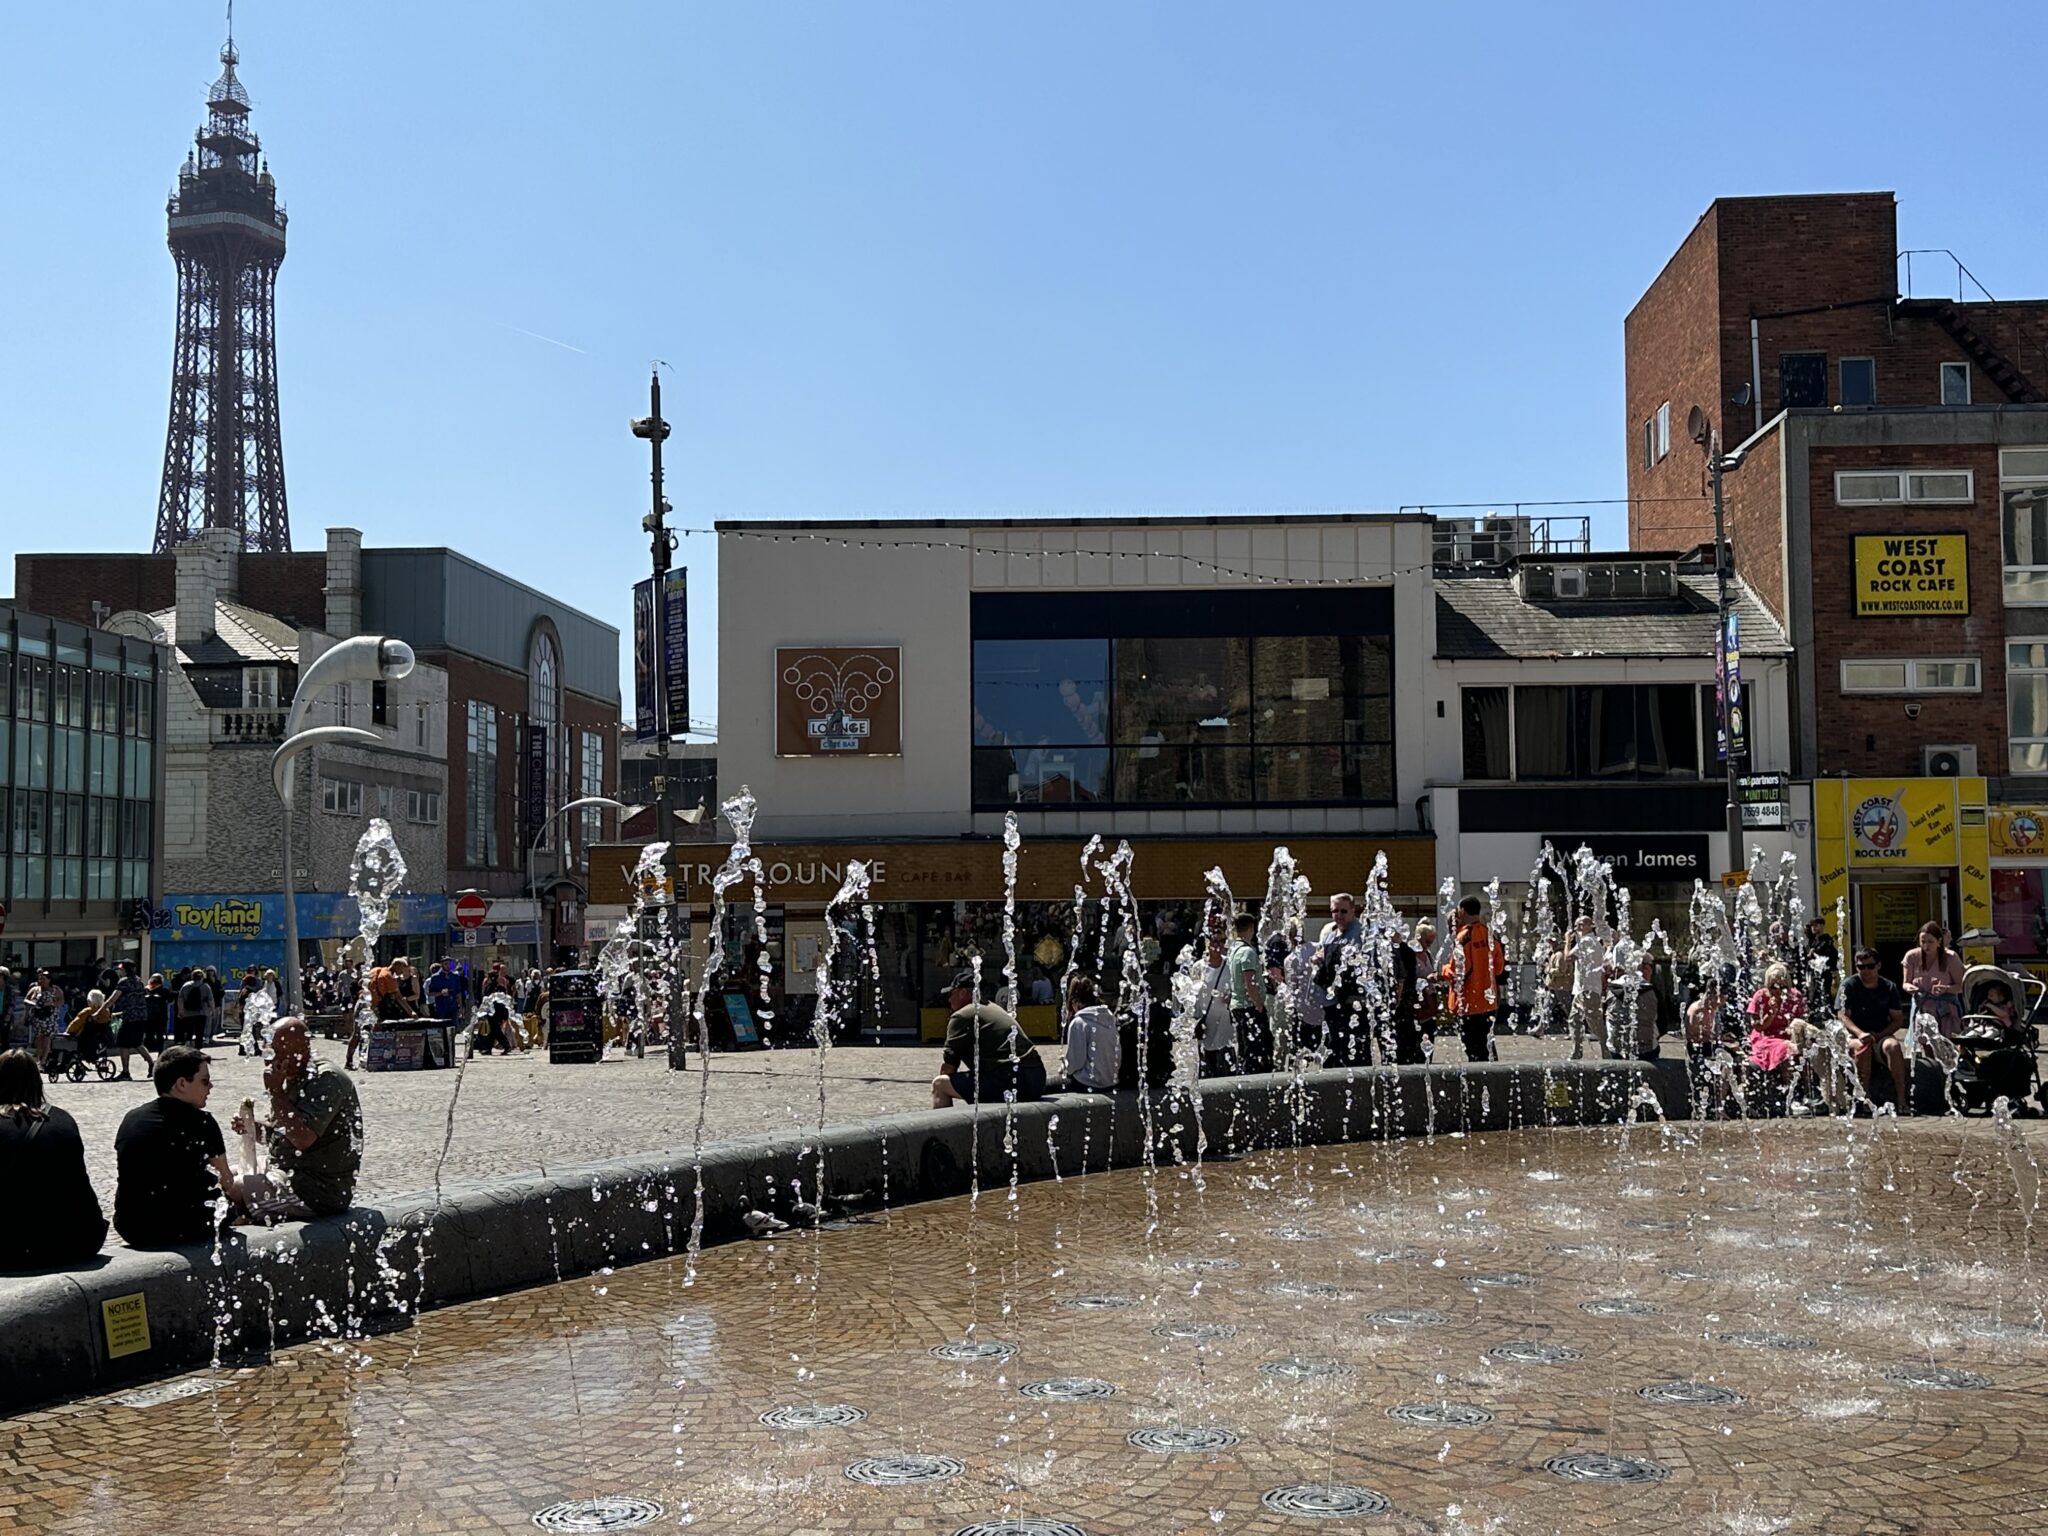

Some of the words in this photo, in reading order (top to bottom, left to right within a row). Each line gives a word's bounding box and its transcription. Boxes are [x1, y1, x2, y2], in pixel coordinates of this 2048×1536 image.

[1884, 539, 1938, 556] WEST
[1877, 559, 1946, 576] COAST
[1870, 580, 1911, 592] ROCK
[1917, 579, 1955, 591] CAFE
[1861, 600, 1964, 611] WWW.WESTCOASTROCK.CO.UK
[532, 733, 542, 758] THE
[532, 759, 542, 804] CHINESE
[1770, 788, 1779, 799] LET
[1761, 805, 1780, 816] 4848
[1853, 810, 1863, 838] WEST
[1861, 797, 1893, 811] COAST
[1910, 813, 1927, 828] Local
[1926, 803, 1946, 818] Family
[1928, 820, 1940, 831] Run
[1925, 833, 1941, 846] Since
[1635, 849, 1697, 867] James
[1855, 849, 1880, 858] ROCK
[1883, 848, 1907, 857] CAFE
[2005, 847, 2024, 855] ROCK
[2026, 847, 2044, 855] CAFE
[945, 871, 973, 882] BAR
[1964, 865, 1985, 881] Ribs
[1964, 894, 1987, 909] Beer
[175, 901, 260, 930] Toyland
[214, 924, 260, 936] Toyshop
[108, 1299, 141, 1314] NOTICE
